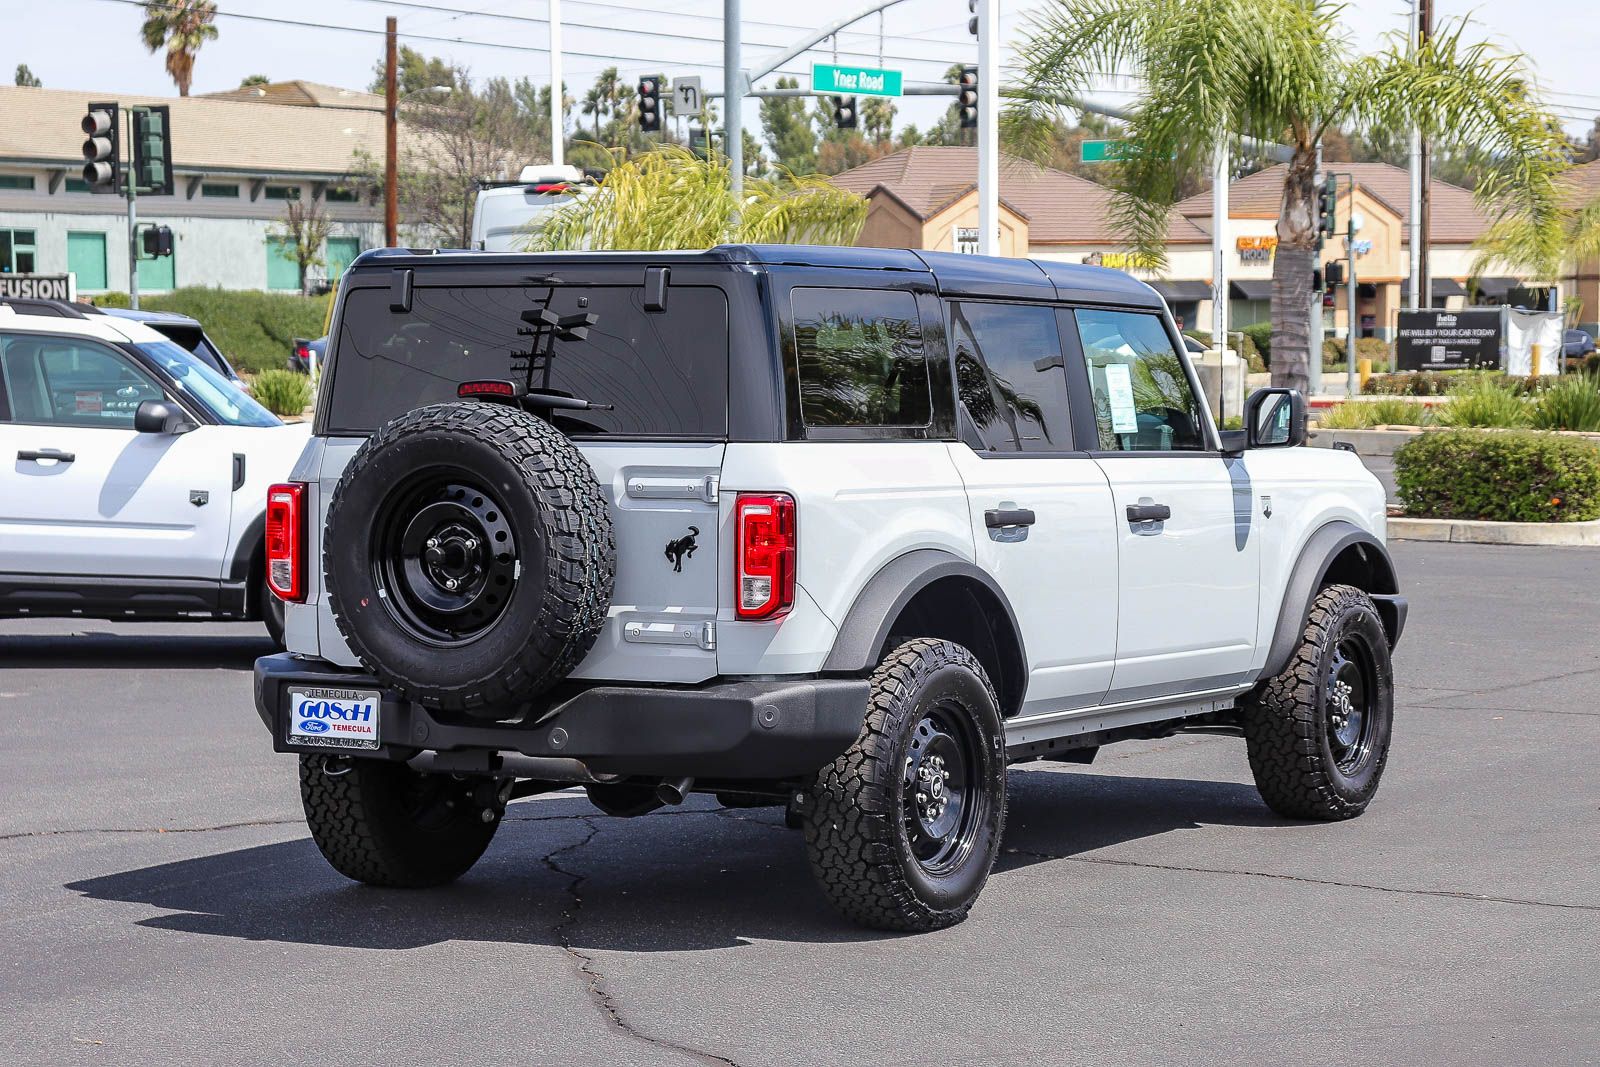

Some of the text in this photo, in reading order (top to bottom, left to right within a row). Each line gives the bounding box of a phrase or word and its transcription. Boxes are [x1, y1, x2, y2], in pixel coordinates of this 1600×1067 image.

[833, 69, 884, 91] Ynez Road
[1237, 237, 1278, 249] ESCAP
[0, 279, 67, 299] FUSION
[1473, 329, 1496, 337] TODAY
[310, 689, 358, 699] TEMECULA
[305, 721, 372, 733] Ford TEMECULA
